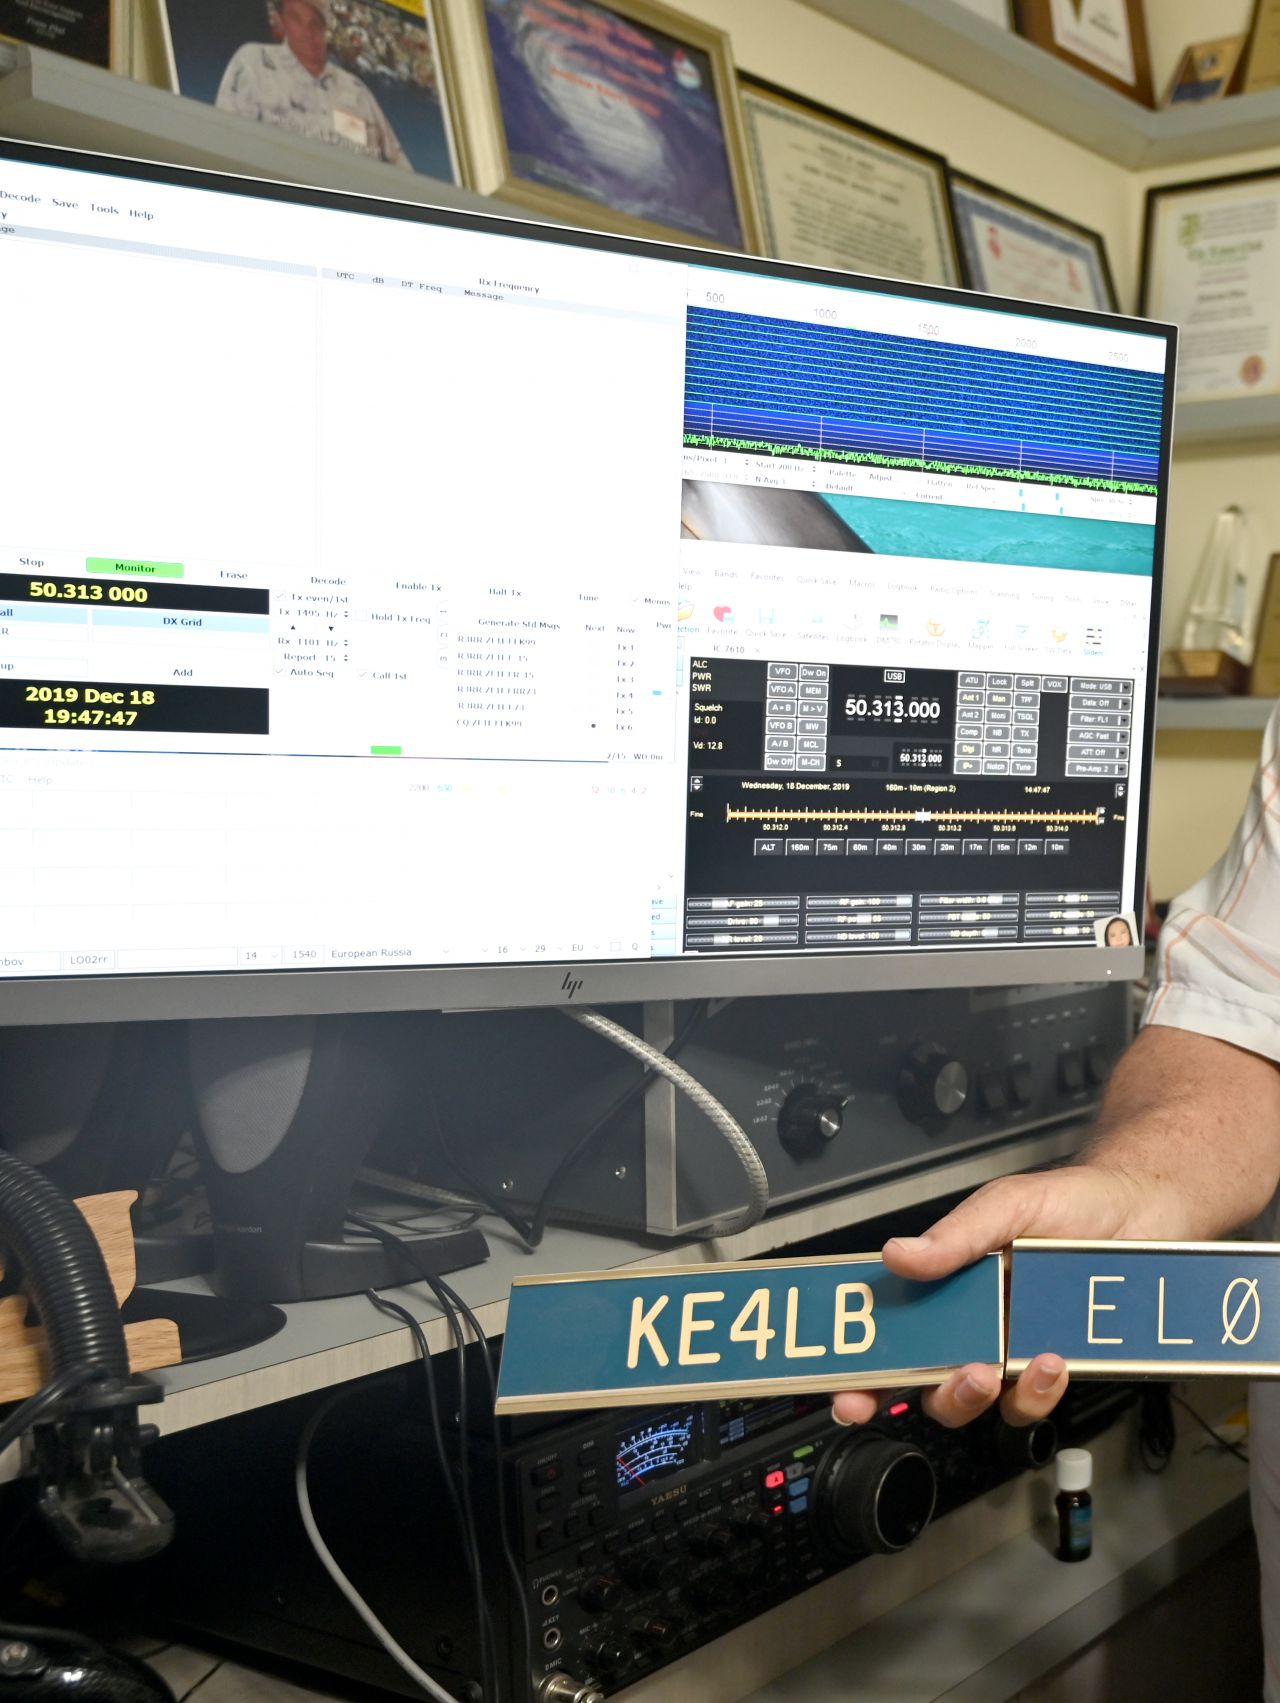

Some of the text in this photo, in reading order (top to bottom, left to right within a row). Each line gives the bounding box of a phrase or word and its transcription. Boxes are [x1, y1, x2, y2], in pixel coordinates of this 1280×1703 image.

[0, 190, 154, 221] Decode Save Tools Help
[336, 271, 504, 301] UTC dB DT Freq Message
[706, 292, 726, 304] 500
[814, 308, 838, 320] 1000
[918, 324, 940, 336] 1500
[1015, 338, 1038, 350] 2000
[1107, 352, 1130, 362] 2500
[19, 557, 45, 568] Stop
[115, 562, 156, 574] Monitor
[682, 568, 700, 576] View
[220, 570, 248, 580] Erase
[714, 570, 738, 579] Bands
[750, 571, 784, 582] Favorites
[310, 576, 346, 586] Decode
[30, 582, 148, 602] 50.313 000
[396, 582, 427, 592] Enable
[488, 587, 506, 596] Halt
[372, 612, 393, 622] Hold
[162, 617, 202, 628] DX Grid
[478, 618, 520, 628] Generate
[585, 624, 636, 634] Next Now
[278, 637, 290, 645] Rx
[284, 652, 316, 662] Report
[692, 660, 708, 668] ALC
[172, 668, 193, 677] Add
[290, 669, 334, 680] Auto Seq
[372, 672, 390, 680] Call
[692, 672, 712, 680] PWR
[887, 672, 902, 680] USB
[692, 684, 712, 692] SWR
[26, 686, 155, 704] 2019 Dec 18
[694, 703, 723, 712] Squelch
[845, 698, 940, 718] 50.313.000
[45, 709, 138, 726] 19:47:47
[704, 716, 716, 724] 0.0
[960, 728, 978, 737] Comp
[693, 742, 723, 750] Vd: 12.8
[900, 752, 942, 763] 50.313.000
[742, 782, 784, 791] Wednesday,
[786, 782, 794, 790] 18
[796, 782, 831, 792] December,
[924, 785, 948, 794] (Region
[572, 944, 584, 952] EU
[246, 952, 257, 960] 14
[292, 950, 317, 959] 1540
[331, 948, 412, 960] European Russia
[626, 1282, 876, 1369] KE4LB
[651, 1484, 688, 1506] YAESU
